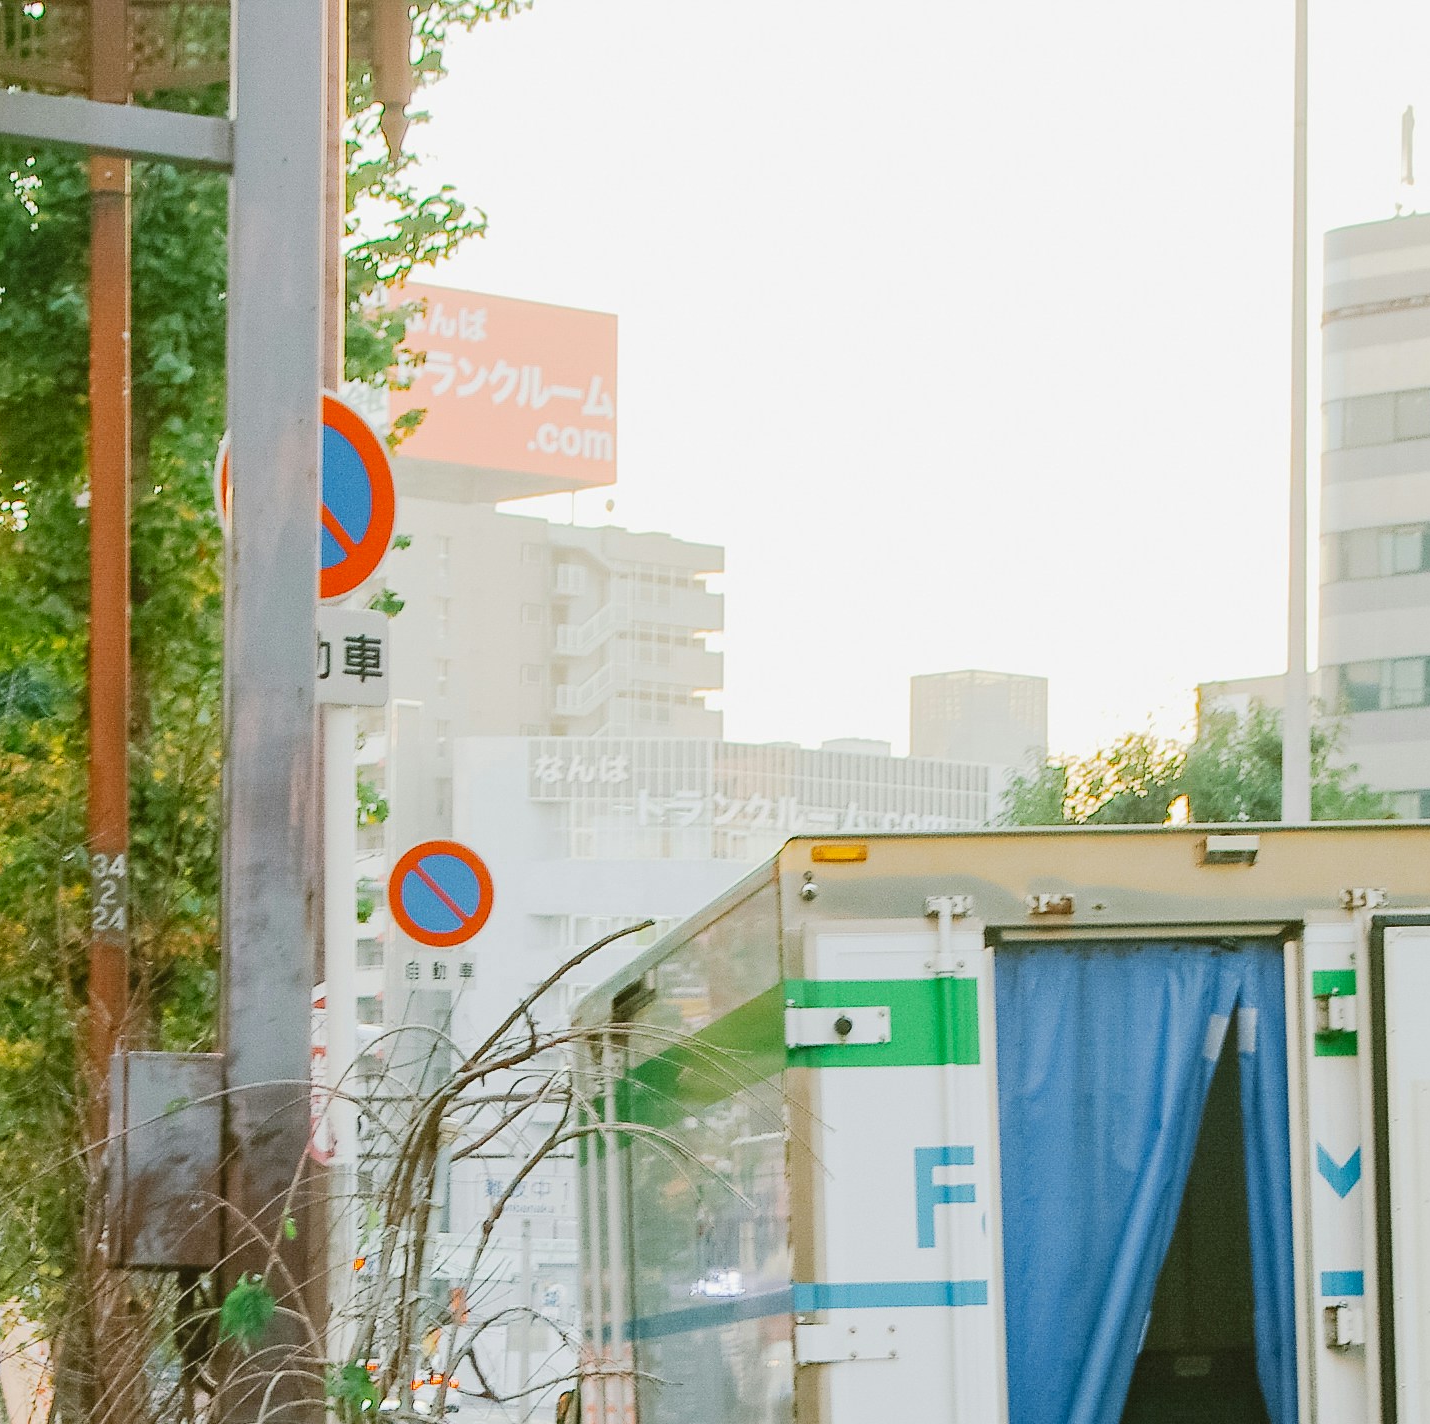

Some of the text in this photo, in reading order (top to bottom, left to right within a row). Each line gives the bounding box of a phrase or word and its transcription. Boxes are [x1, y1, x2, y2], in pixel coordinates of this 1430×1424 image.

[526, 422, 614, 462] .com
[100, 880, 117, 905] 2
[406, 961, 474, 980] 自動車
